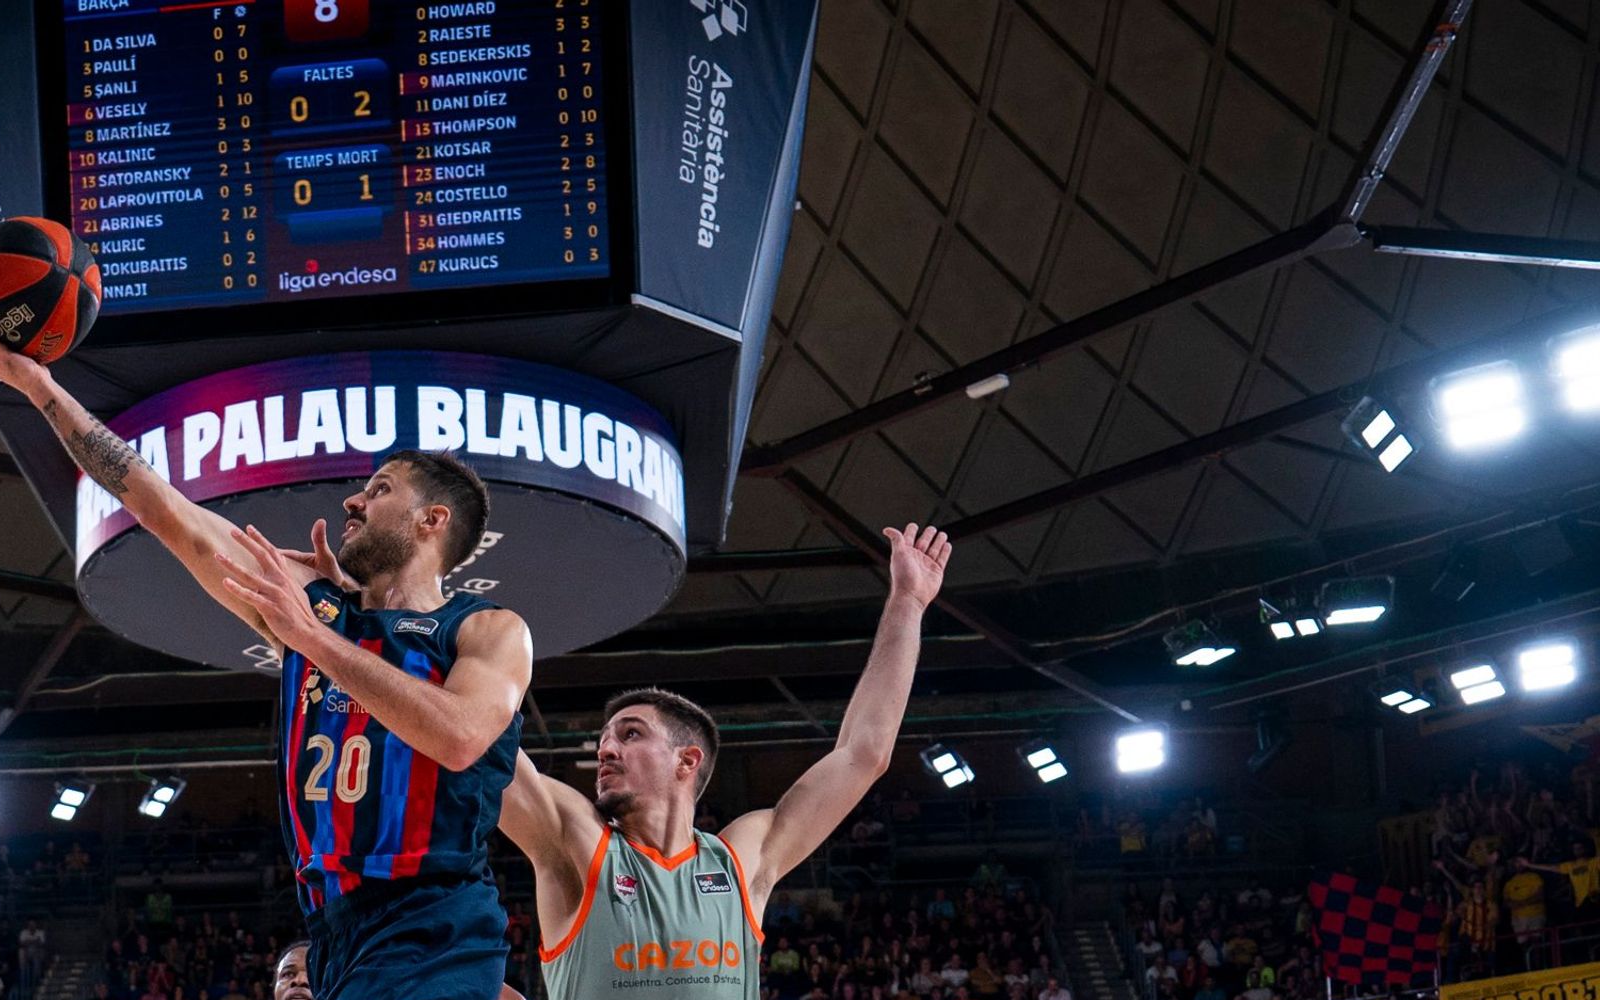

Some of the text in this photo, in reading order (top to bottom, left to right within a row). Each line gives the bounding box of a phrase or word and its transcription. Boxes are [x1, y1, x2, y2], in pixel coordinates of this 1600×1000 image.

[214, 8, 221, 20] F
[314, 0, 339, 22] 8
[416, 7, 426, 20] 0
[428, 1, 495, 19] HOWARD
[84, 25, 246, 52] 1 DA SILVA 0 7
[418, 16, 590, 43] 2 RAIESTE 3 3
[83, 48, 248, 75] 3 PAULÍ 0 0
[418, 39, 591, 66] 8 SEDEKERSKIS 1 2
[84, 85, 93, 98] 5
[217, 73, 223, 85] 1
[239, 70, 249, 83] 5
[304, 65, 354, 82] FALTES
[419, 62, 591, 88] 9 MARINKOVIC 1 7
[85, 92, 253, 120] 6 VESELY 1 10
[290, 90, 371, 122] 0 2
[416, 85, 593, 112] 11 DANI DÍEZ 0 0
[85, 115, 250, 143] 8 MARTÍNEZ 3 0
[415, 109, 597, 136] 13 THOMPSON 0 10
[679, 55, 711, 185] Sanitària
[79, 139, 251, 166] 10 KALINIC 0 3
[286, 149, 379, 170] TEMPS MORT
[416, 133, 595, 159] 21 KOTSAR 2 3
[697, 62, 733, 249] Assistència
[82, 162, 252, 189] 13 SATORANSKY 2 1
[416, 155, 595, 182] 23 ENOCH 2 8
[80, 184, 253, 211] 20 LAPROVITTOLA 0 5
[293, 174, 374, 206] 0 1
[415, 178, 596, 205] 24 COSTELLO 2 5
[84, 206, 257, 233] 21 ABRINES 2 12
[418, 201, 597, 227] 31 GIEDRAITIS 1 9
[101, 238, 146, 254] KURIC
[223, 231, 231, 244] 1
[246, 229, 255, 242] 6
[417, 225, 598, 250] 34 HOMMES 3 0
[102, 251, 256, 277] JOKUBAITIS 0 2
[418, 248, 599, 273] 47 KURUCS 0 3
[104, 274, 257, 299] NNAJI 0 0
[279, 267, 397, 293] liga endesa
[183, 386, 397, 481] PALAU
[305, 734, 371, 803] 20
[614, 939, 740, 971] CAZOO
